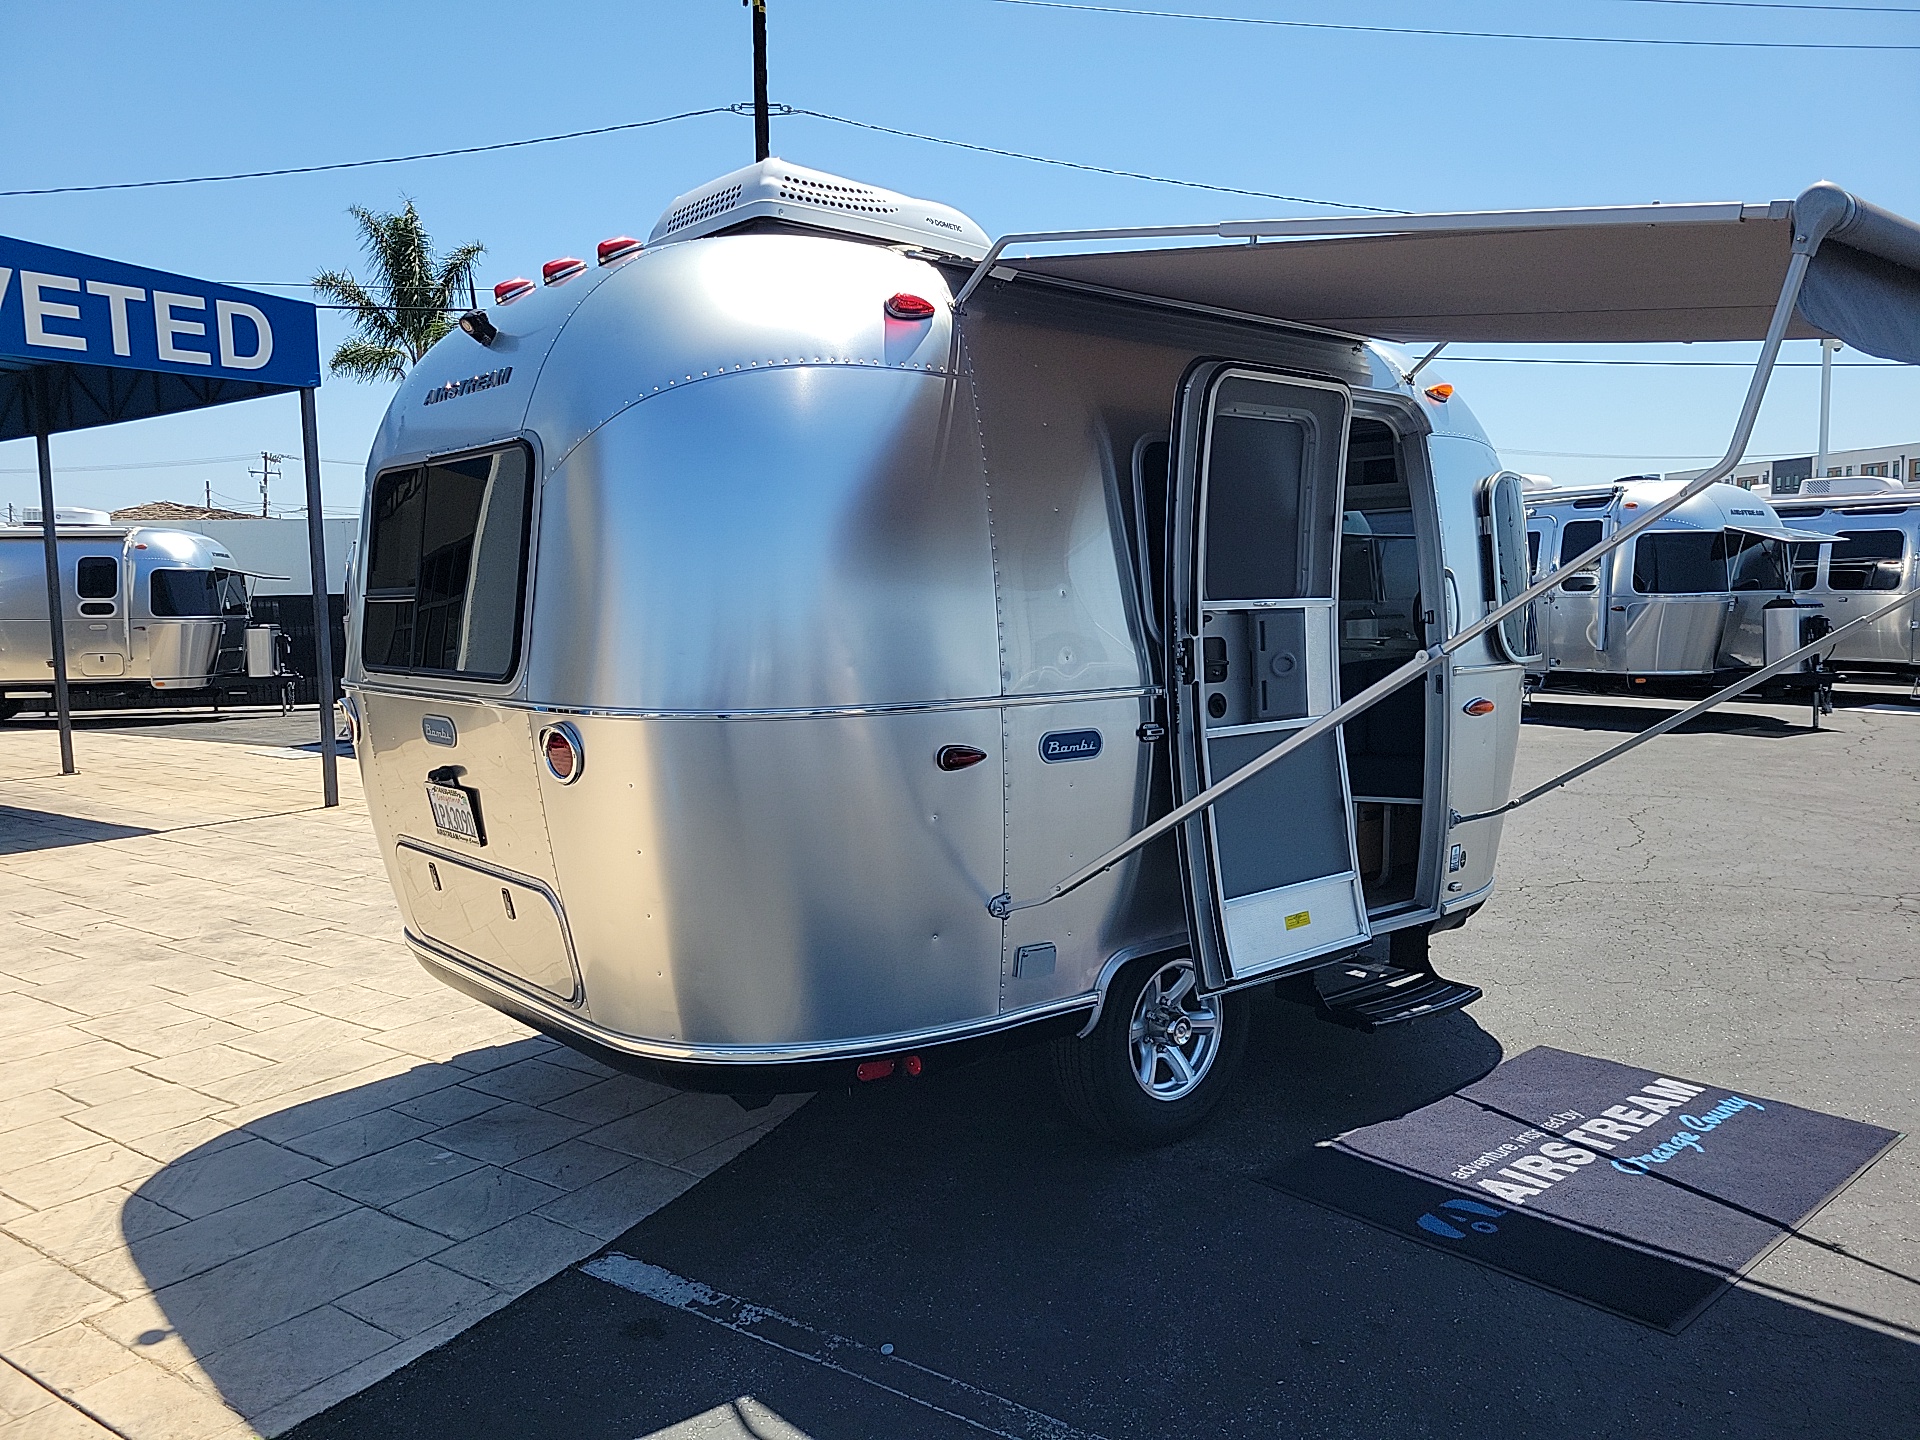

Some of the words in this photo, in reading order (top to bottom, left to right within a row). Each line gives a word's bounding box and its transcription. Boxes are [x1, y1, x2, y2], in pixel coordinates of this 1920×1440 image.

[934, 219, 963, 232] DOMETIC
[0, 266, 273, 370] ETED
[423, 366, 513, 406] AIRSTREAM
[425, 723, 452, 739] Bambi
[1048, 739, 1097, 754] Bambi
[1450, 1143, 1526, 1179] adventure,
[1509, 1116, 1568, 1144] inspred
[1552, 1109, 1585, 1121] by
[1476, 1077, 1707, 1205] AIRSTREAM
[1610, 1131, 1706, 1175] Orange
[1678, 1095, 1766, 1132] County
